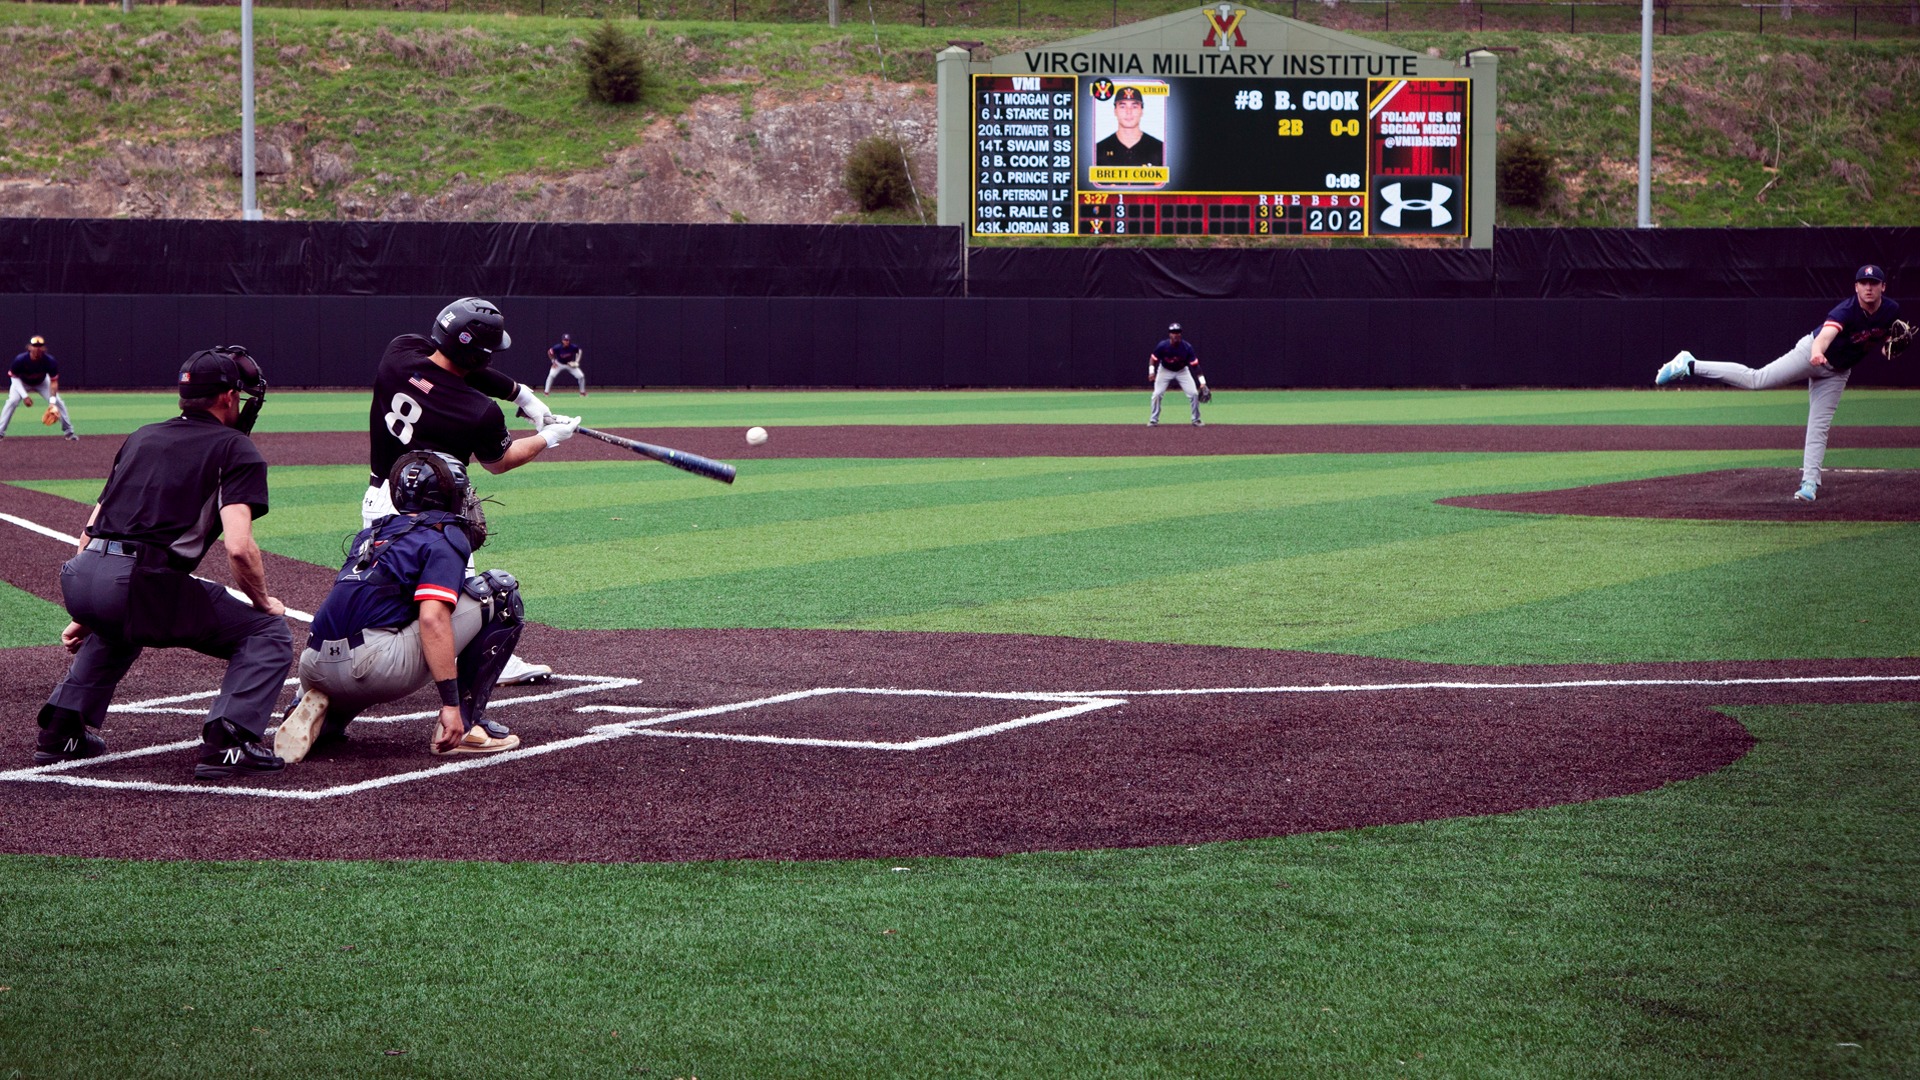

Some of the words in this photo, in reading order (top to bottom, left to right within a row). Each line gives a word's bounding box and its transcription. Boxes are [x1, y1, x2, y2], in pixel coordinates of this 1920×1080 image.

[1025, 52, 1143, 74] VIRGINIA
[1153, 53, 1274, 75] MILITARY
[1284, 54, 1418, 76] INSTITUTE
[1012, 77, 1040, 90] VMI
[983, 93, 989, 105] 1
[993, 93, 1002, 105] T.
[1004, 93, 1049, 105] MORGAN
[1053, 94, 1071, 105] CF
[1235, 90, 1263, 110] #8
[1274, 90, 1296, 110] B.
[1302, 90, 1359, 110] COOK
[981, 108, 990, 120] 6
[993, 108, 1003, 120] J.
[1006, 108, 1049, 120] STARKE
[1053, 108, 1072, 120] DH
[1381, 112, 1426, 122] FOLLOW
[1428, 112, 1443, 122] US
[1445, 112, 1461, 122] ON
[1004, 125, 1049, 136] FITZWATER
[1054, 125, 1070, 136] 1B
[1278, 119, 1303, 136] 2B
[1330, 119, 1360, 136] 0-0
[1381, 124, 1420, 135] SOCIAL
[1422, 124, 1461, 135] MEDIA!
[1007, 140, 1049, 152] SWAIM
[1053, 140, 1071, 152] SS
[982, 155, 990, 167] 8
[994, 155, 1006, 167] B.
[1010, 155, 1048, 167] COOK
[1053, 155, 1070, 167] 2B
[981, 172, 989, 184] 2
[993, 172, 1005, 184] O.
[1008, 172, 1048, 184] PRINCE
[1053, 172, 1070, 184] RF
[1096, 170, 1128, 178] BRETT
[1133, 170, 1162, 178] COOK
[1325, 173, 1360, 188] 0:08
[1003, 190, 1048, 201] PETERSON
[1052, 190, 1068, 201] LF
[1084, 194, 1108, 204] 3:27
[1119, 194, 1124, 204] 1
[1259, 195, 1268, 205] R
[1274, 195, 1284, 205] H
[1292, 195, 1300, 205] E
[1311, 195, 1320, 206] B
[1331, 195, 1338, 206] S
[1350, 195, 1360, 206] O
[1009, 206, 1048, 218] RAILE
[1052, 206, 1062, 218] C
[1116, 205, 1125, 217] 3
[1260, 206, 1268, 217] 3
[1275, 206, 1283, 217] 3
[1310, 210, 1322, 230] 2
[1349, 210, 1361, 230] 2
[1005, 222, 1048, 233] JORDAN
[1052, 222, 1069, 233] 3B
[1116, 221, 1124, 233] 2
[1260, 221, 1268, 233] 2
[385, 392, 422, 445] 8
[223, 749, 240, 764] N
